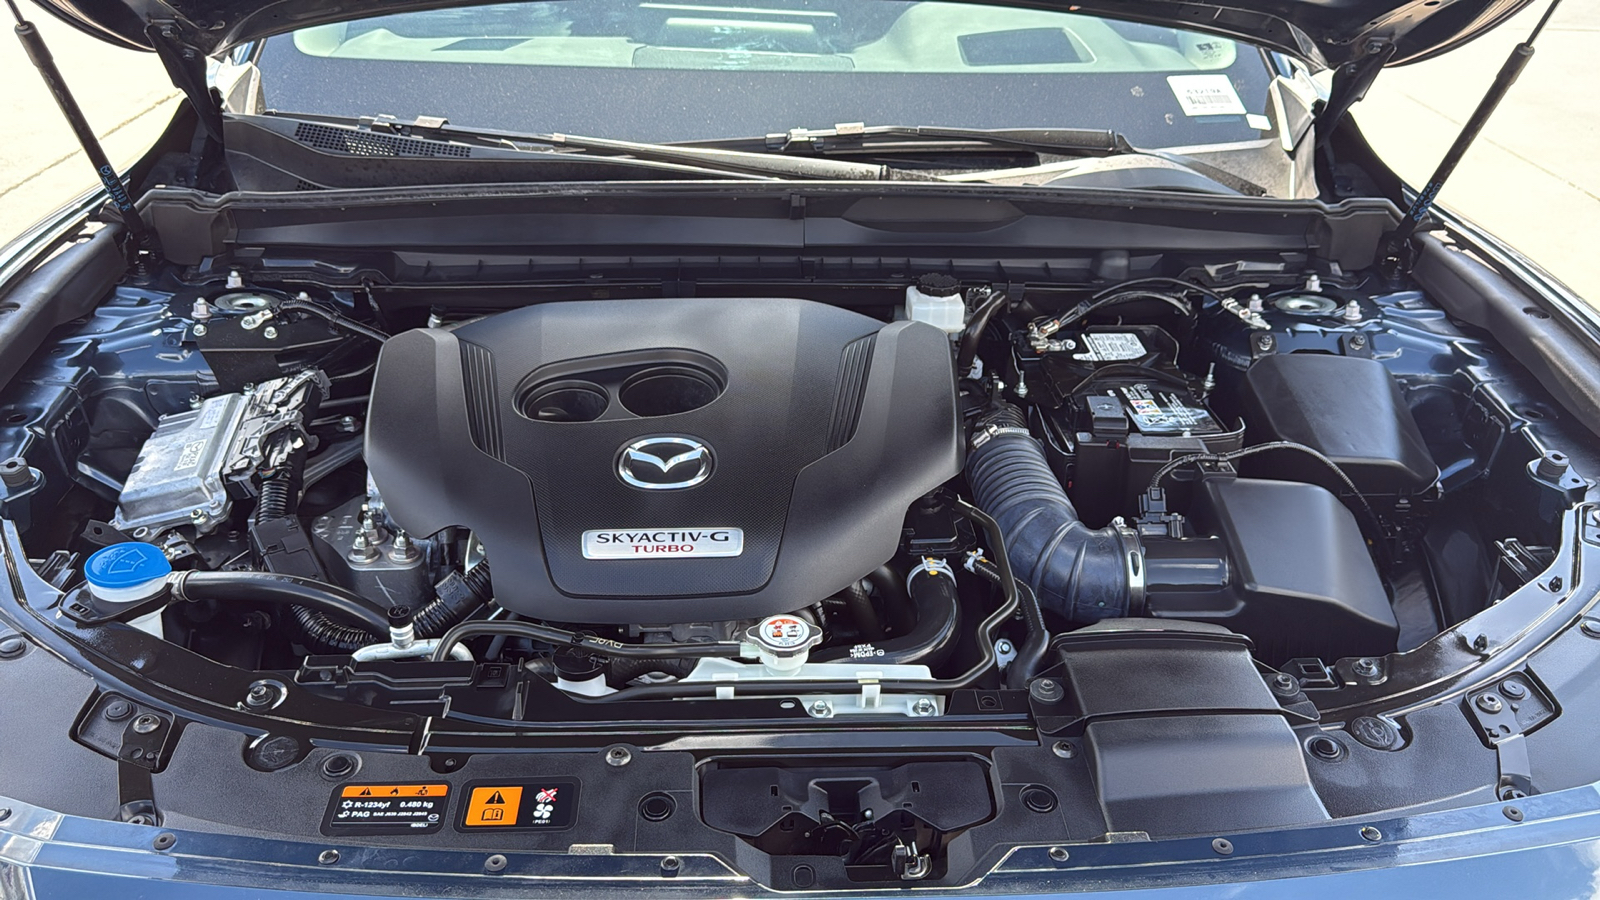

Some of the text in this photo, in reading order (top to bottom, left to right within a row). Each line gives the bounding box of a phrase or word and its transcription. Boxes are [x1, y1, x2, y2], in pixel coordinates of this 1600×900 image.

[596, 531, 730, 543] SKYACTIV-G
[631, 543, 695, 554] TURBO
[354, 801, 391, 809] R-1234yf
[422, 801, 434, 809] kg
[350, 810, 371, 818] PAG
